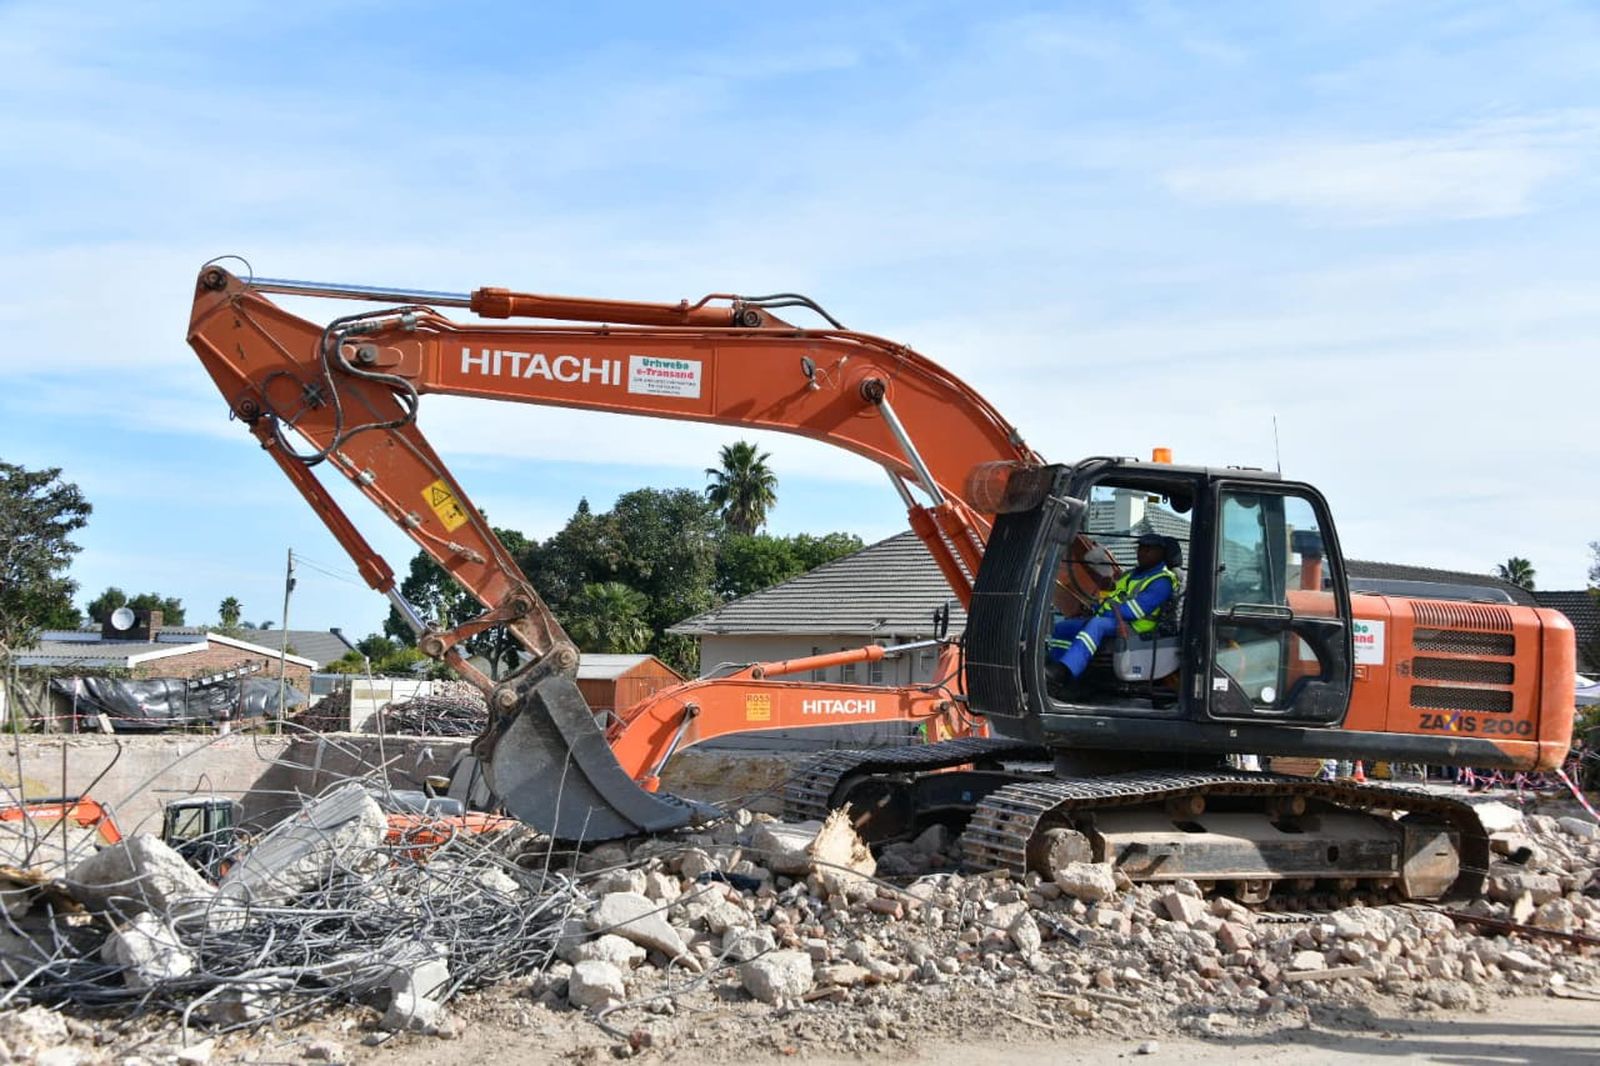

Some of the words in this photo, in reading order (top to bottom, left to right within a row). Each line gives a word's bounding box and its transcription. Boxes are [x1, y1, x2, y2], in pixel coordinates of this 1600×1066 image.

[461, 347, 621, 386] HITACHI
[803, 699, 876, 714] HITACHI
[1419, 710, 1476, 732] ZAXIS
[1482, 718, 1533, 736] 200
